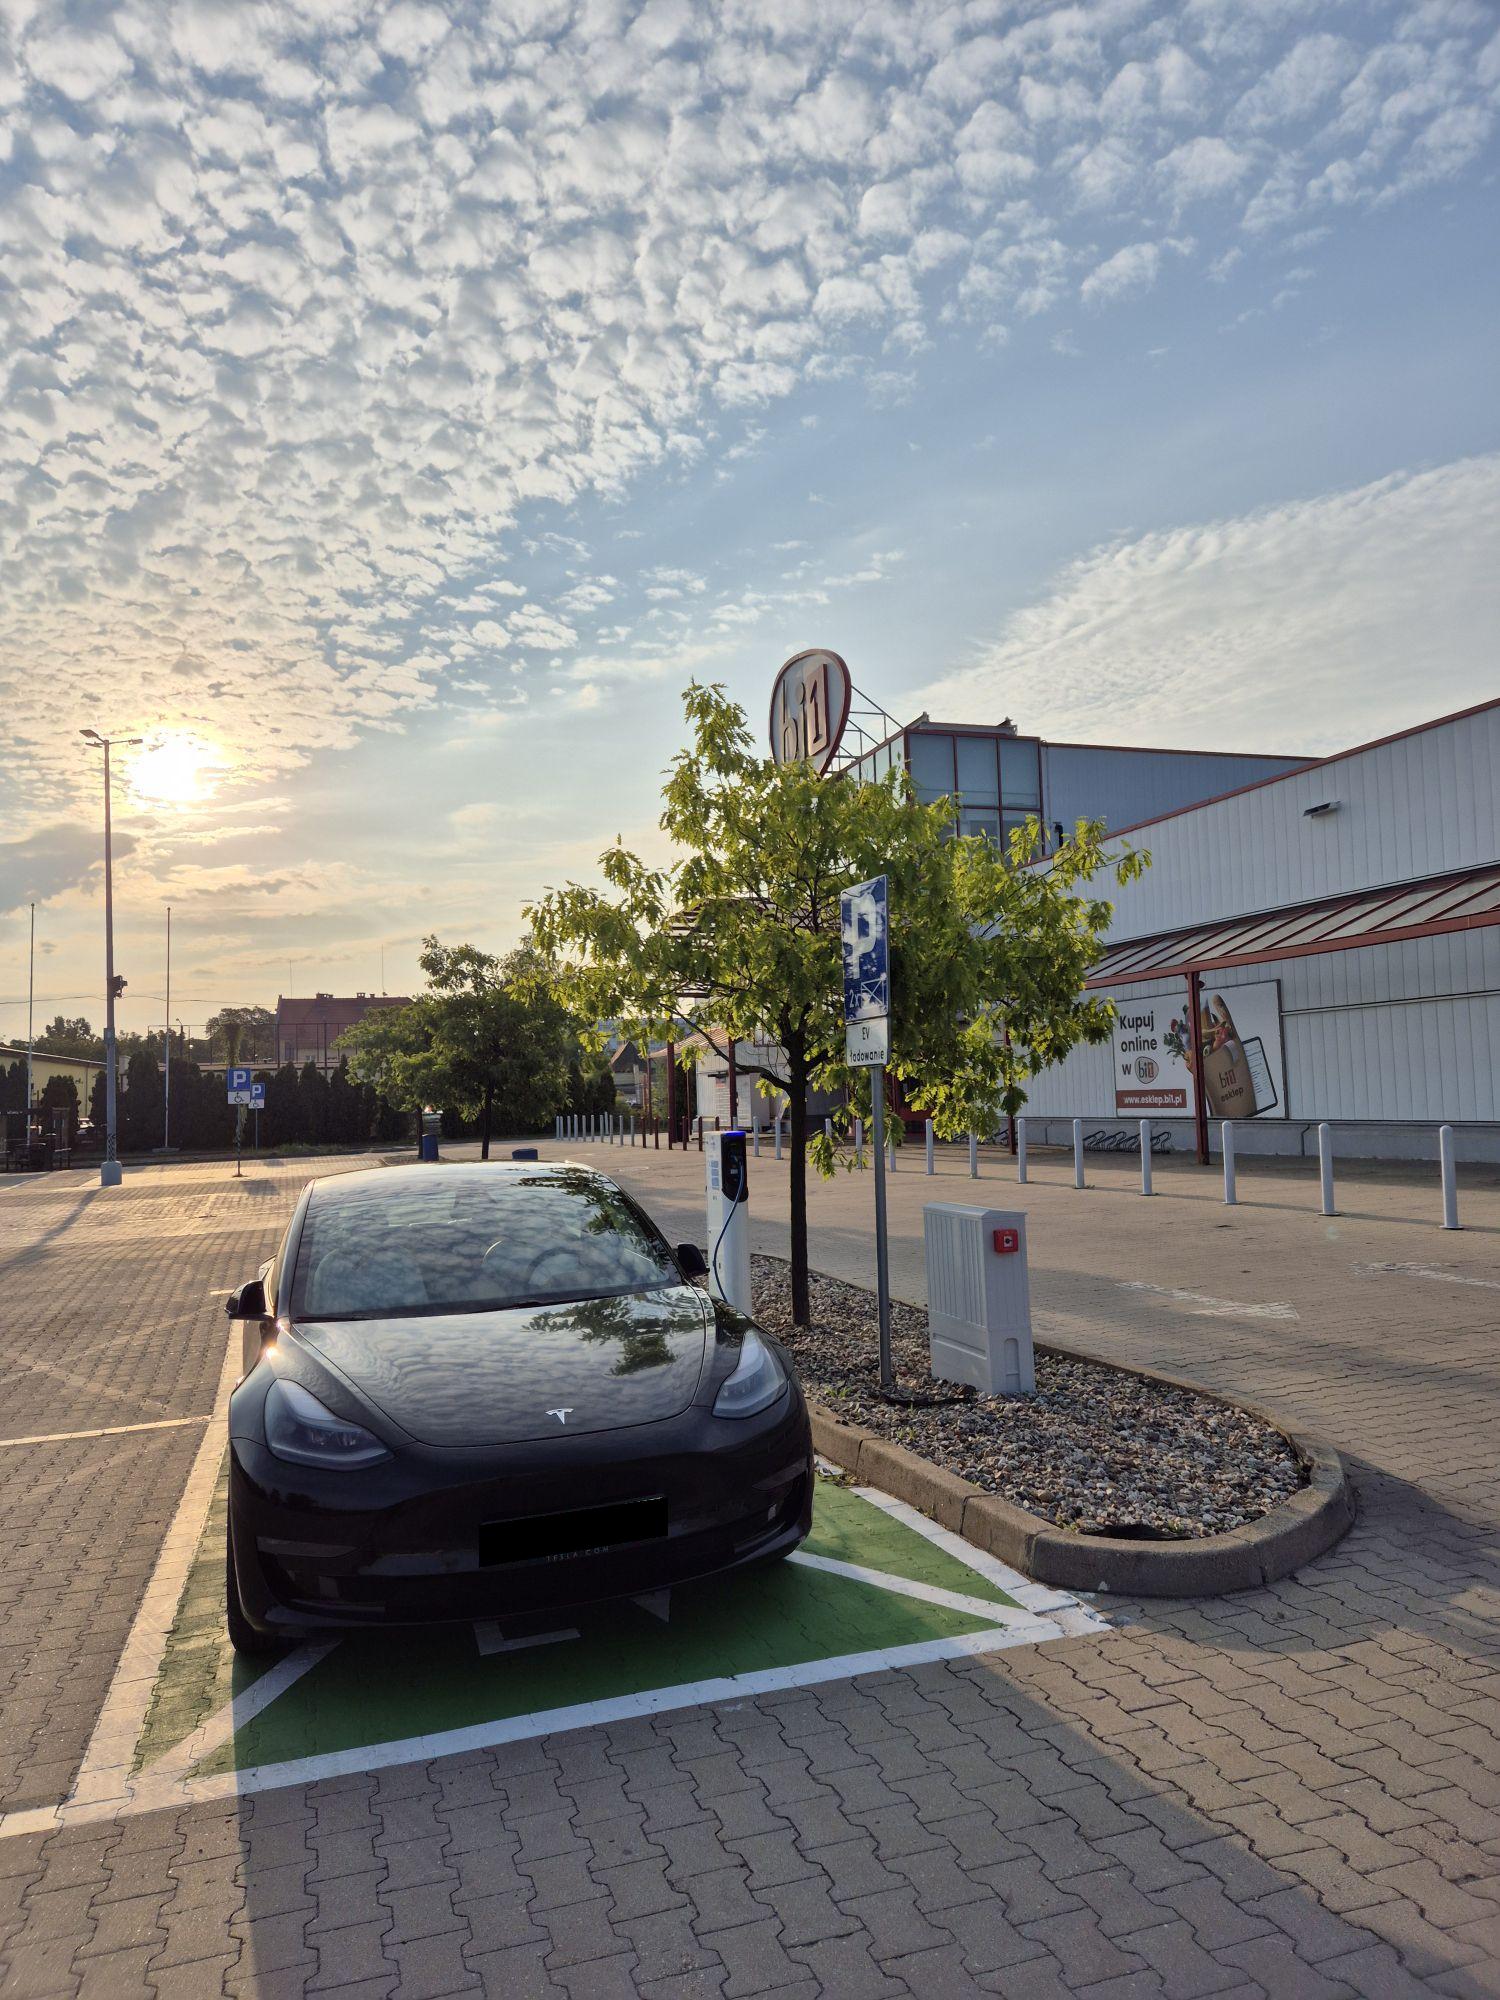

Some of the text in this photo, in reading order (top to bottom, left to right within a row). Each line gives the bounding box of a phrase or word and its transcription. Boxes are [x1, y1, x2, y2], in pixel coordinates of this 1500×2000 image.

[851, 893, 876, 980] P
[1120, 1011, 1154, 1033] Kupuj
[862, 1026, 870, 1040] EV
[1121, 1036, 1157, 1052] online
[1122, 1064, 1131, 1075] w
[233, 1071, 247, 1088] P
[252, 1085, 262, 1098] P
[1221, 1087, 1244, 1102] esklep
[1124, 1094, 1182, 1106] www.esklep.bi1.pl
